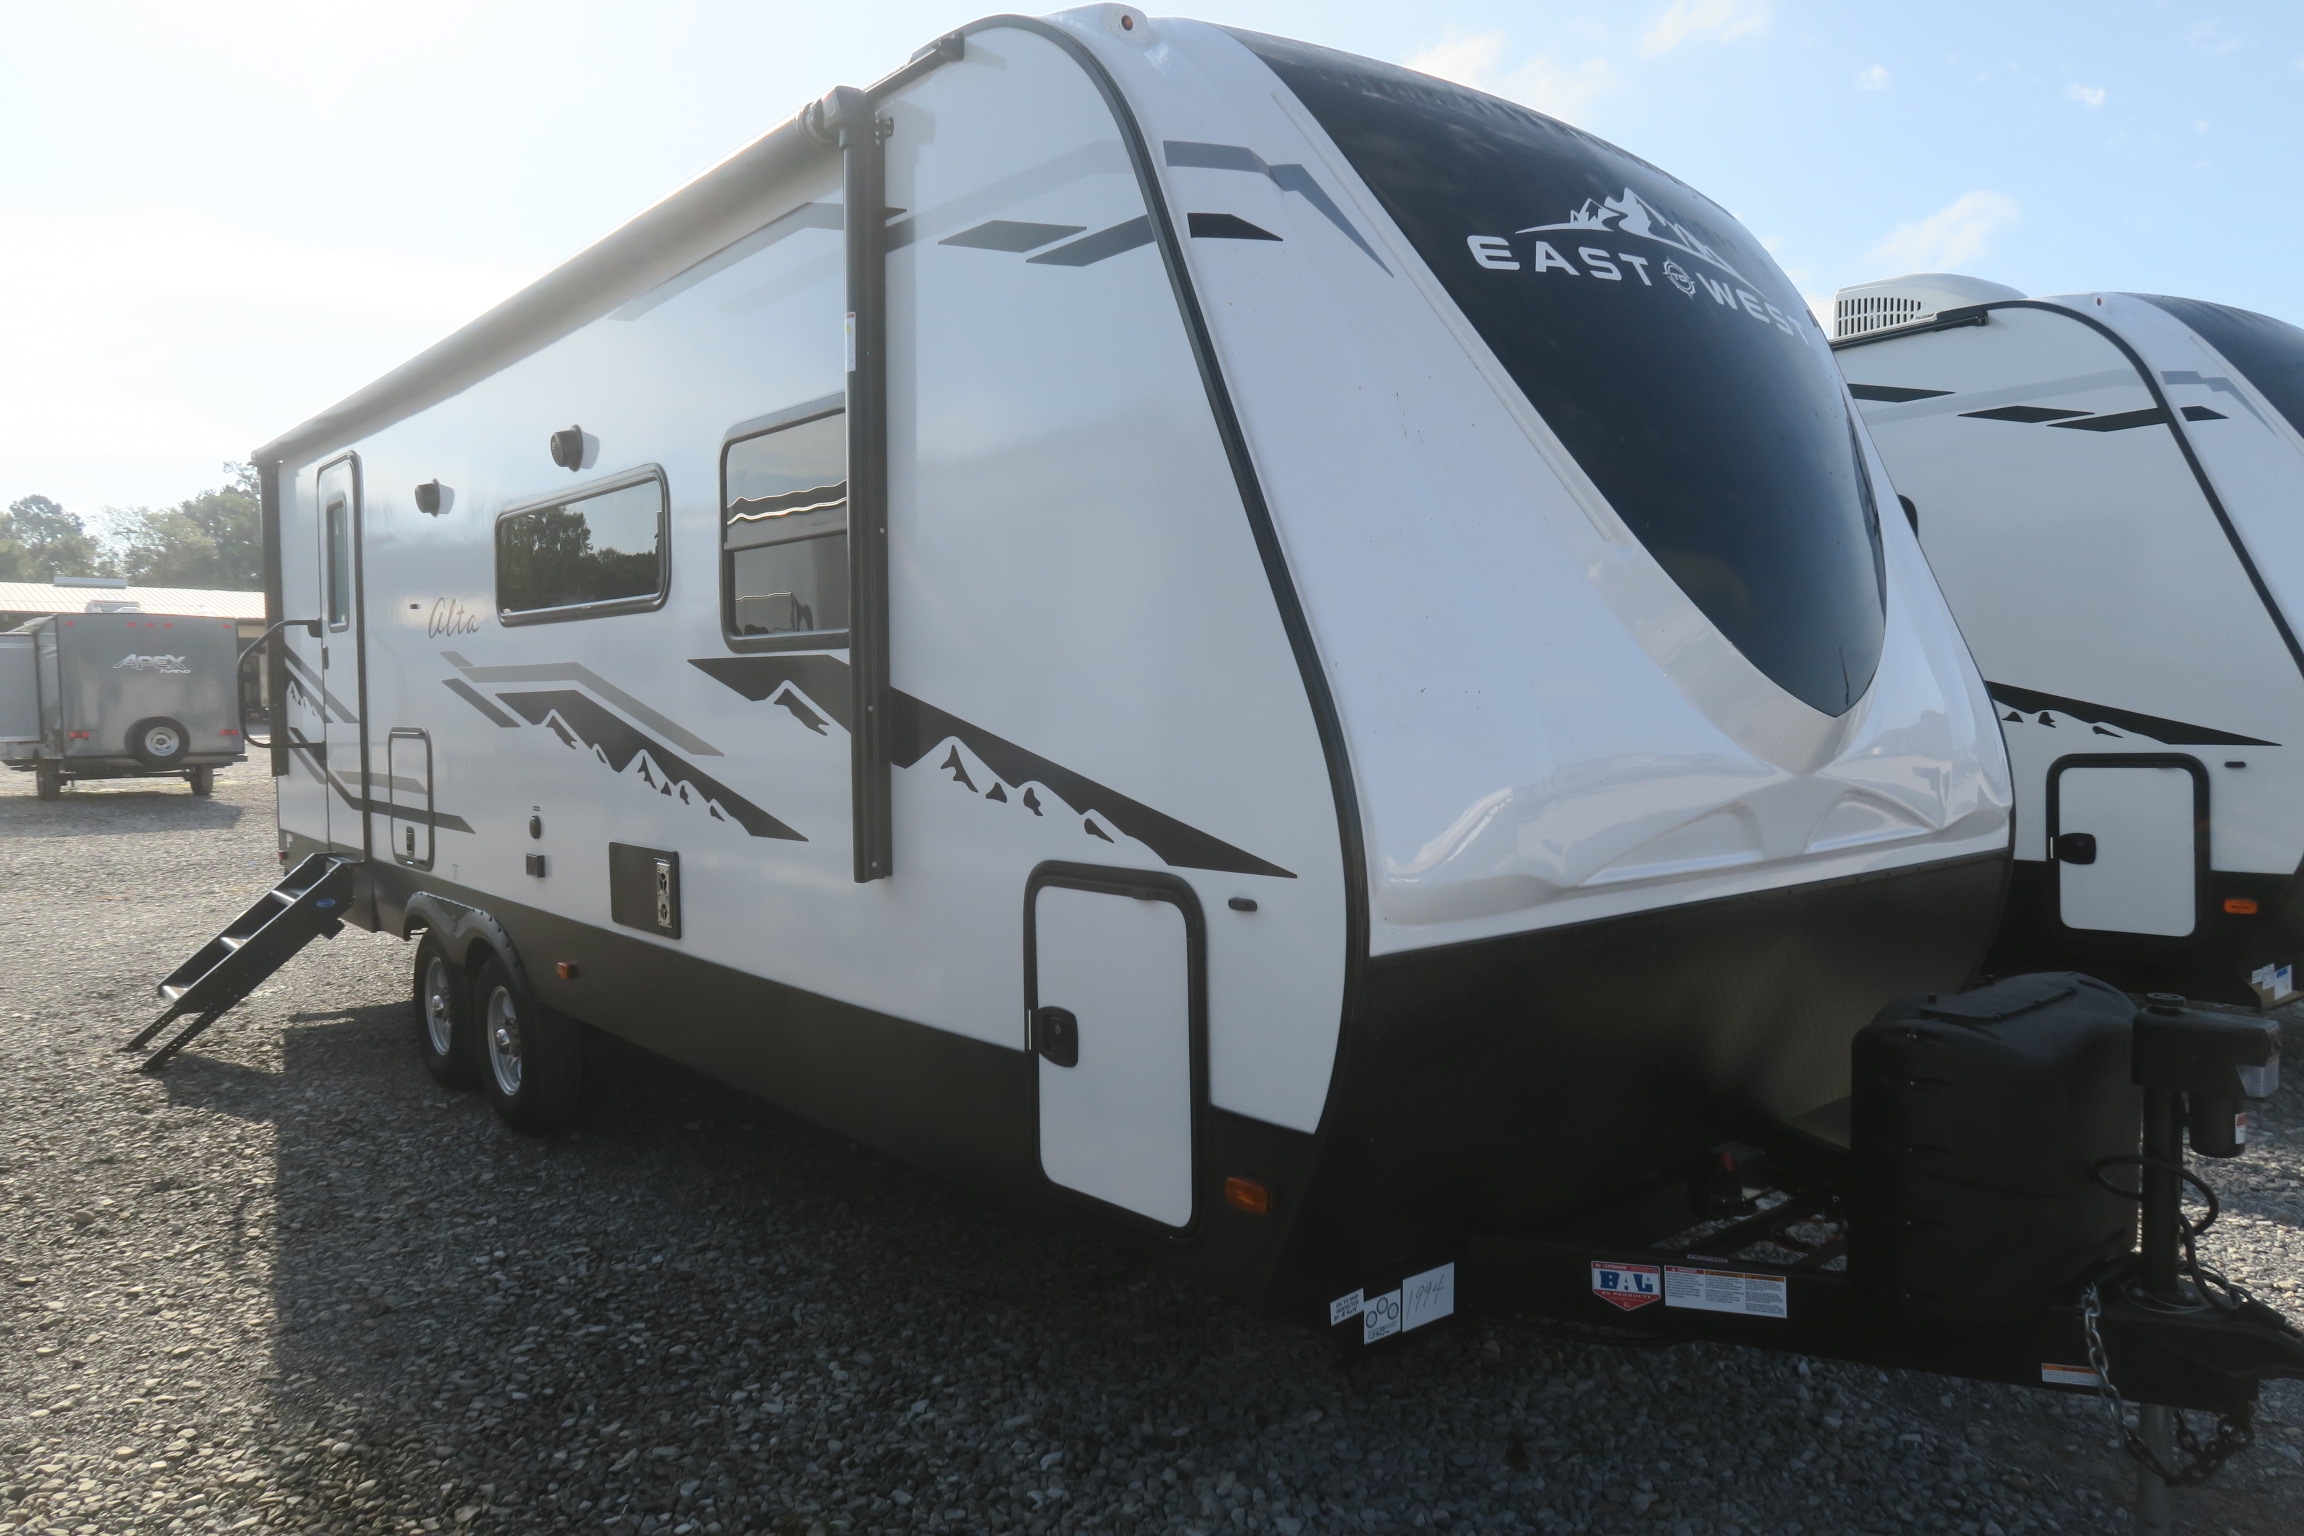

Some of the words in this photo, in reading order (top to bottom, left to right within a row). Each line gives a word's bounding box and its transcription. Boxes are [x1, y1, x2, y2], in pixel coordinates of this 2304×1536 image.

[1466, 234, 1653, 287] EAST
[1695, 272, 1810, 346] WEST
[428, 596, 480, 640] Alta
[112, 653, 186, 671] APEX
[1599, 1270, 1653, 1293] BAL
[1613, 1291, 1651, 1299] PRODUCTS
[1336, 1299, 1360, 1314] INSPECTED
